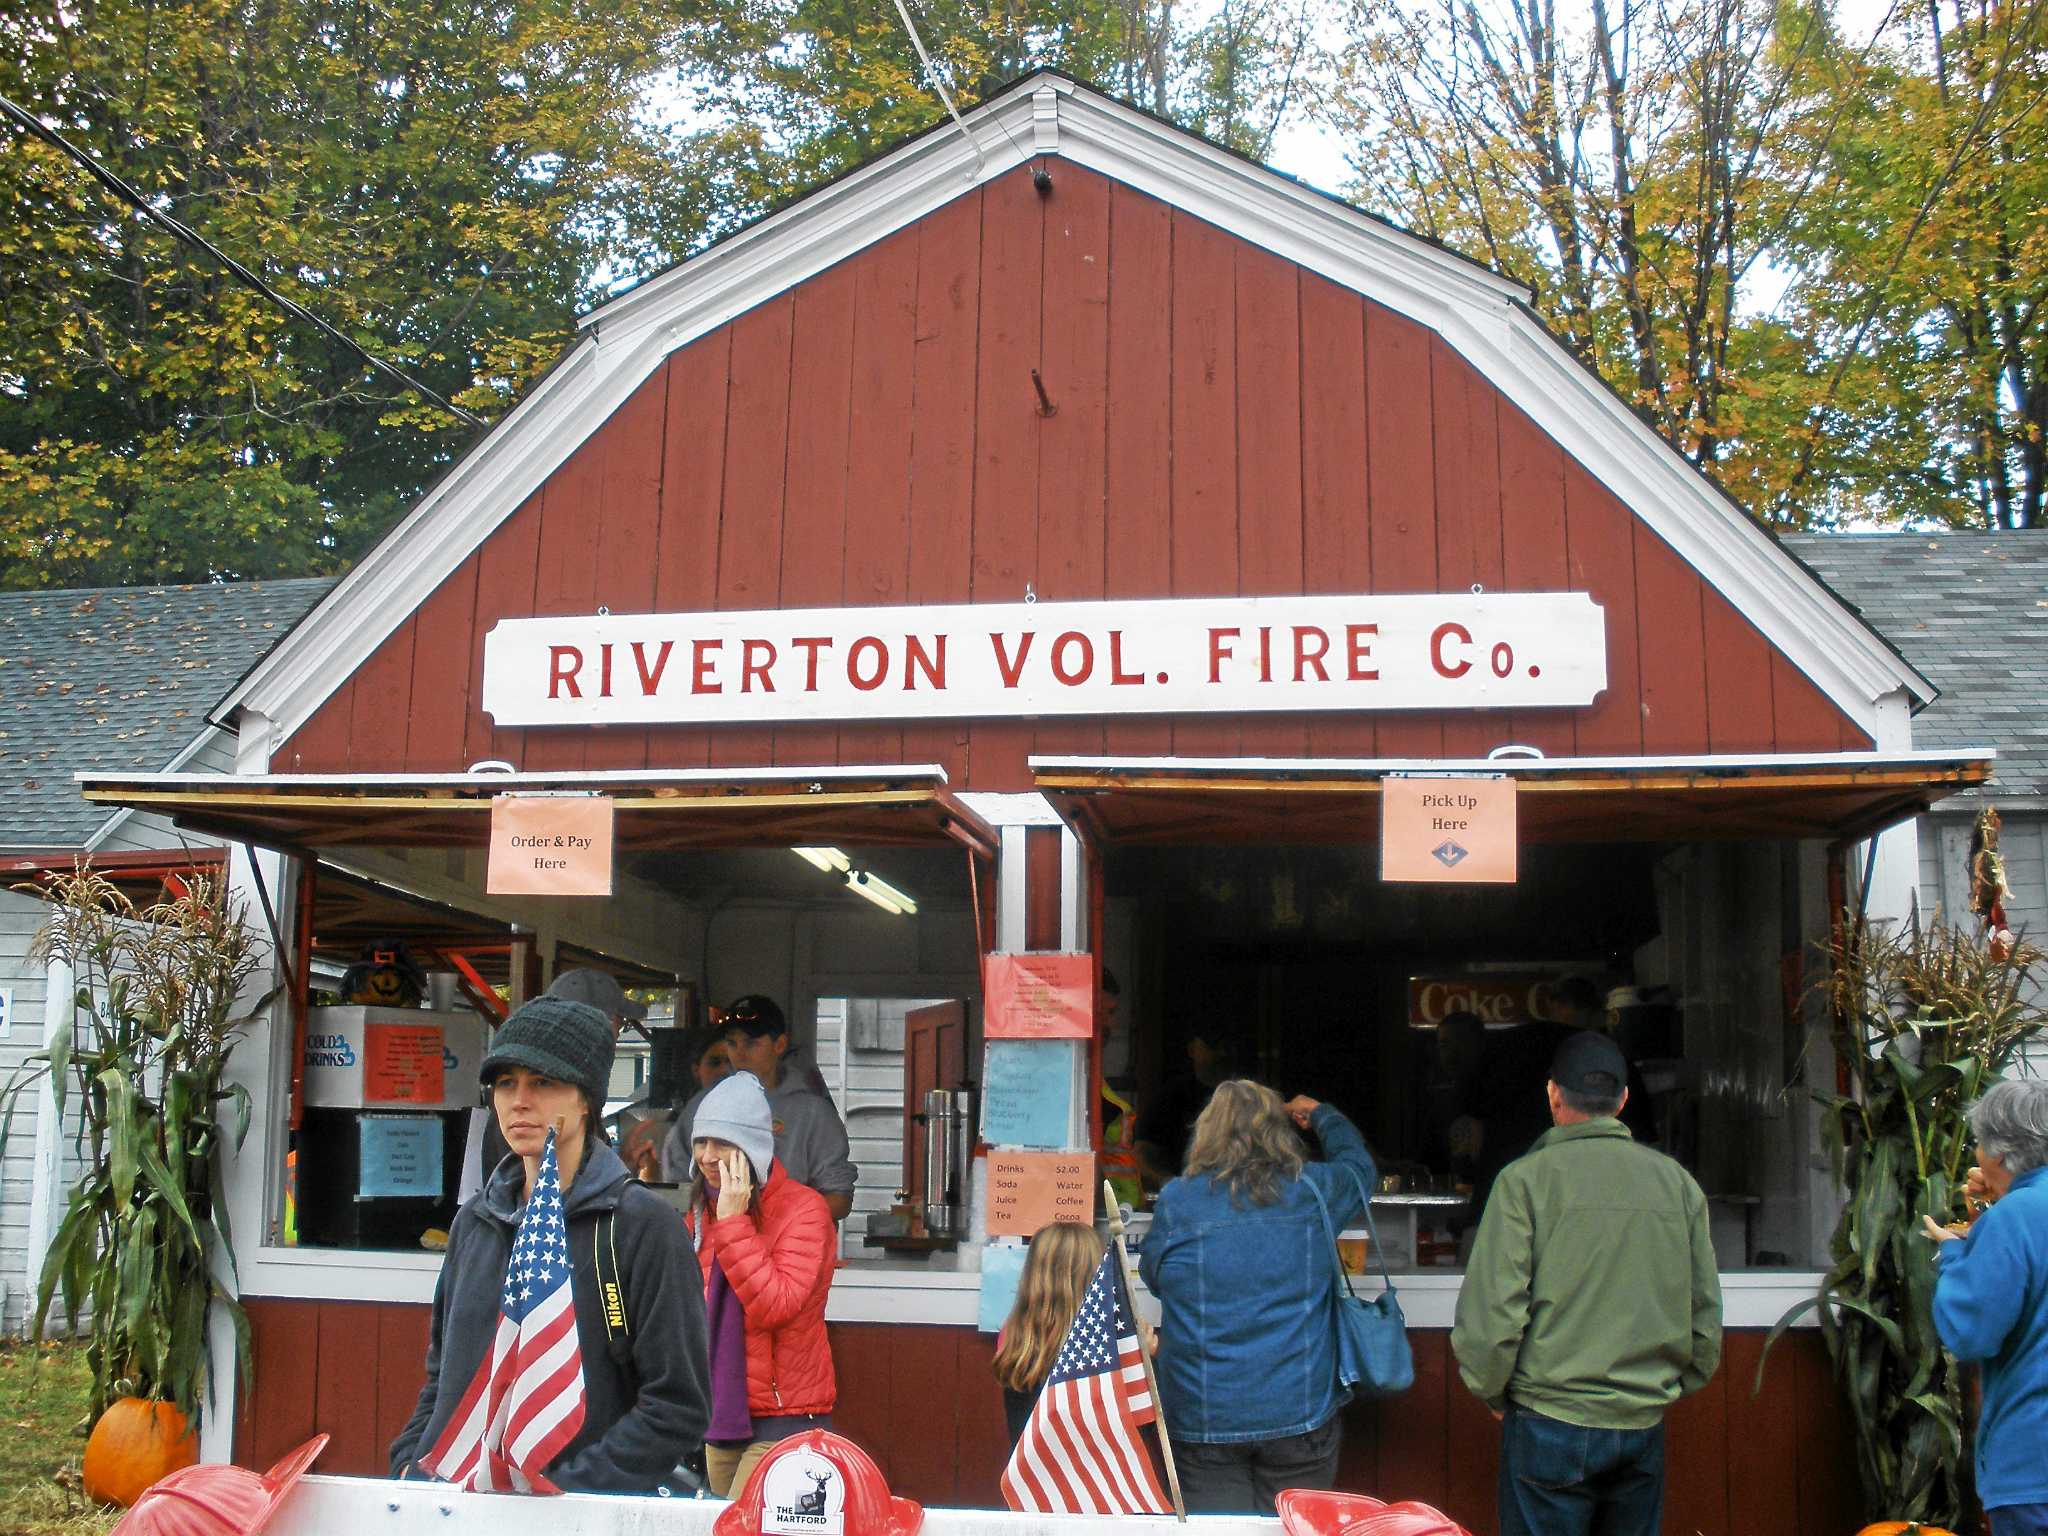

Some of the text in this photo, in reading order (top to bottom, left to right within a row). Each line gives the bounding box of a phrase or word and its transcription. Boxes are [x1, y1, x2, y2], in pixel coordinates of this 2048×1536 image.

[547, 621, 1541, 699] RIVERTON VOL. FIRE Co.
[1422, 794, 1477, 809] Pick Up
[1432, 817, 1468, 830] Here
[511, 836, 592, 849] Order & Pay
[534, 857, 567, 869] Here
[1420, 983, 1515, 1024] Coke
[307, 1034, 336, 1049] COLD
[304, 1052, 345, 1067] DRINKS
[997, 1164, 1025, 1174] Drinks
[996, 1180, 1018, 1189] Soda
[1056, 1181, 1083, 1190] Water
[996, 1195, 1017, 1204] Juice
[1056, 1196, 1084, 1205] Coffee
[996, 1211, 1011, 1220] Tea
[1054, 1212, 1080, 1221] Cocoa
[606, 1282, 623, 1327] Nikon
[776, 1506, 793, 1515] THE
[776, 1515, 827, 1525] HARTFORD
